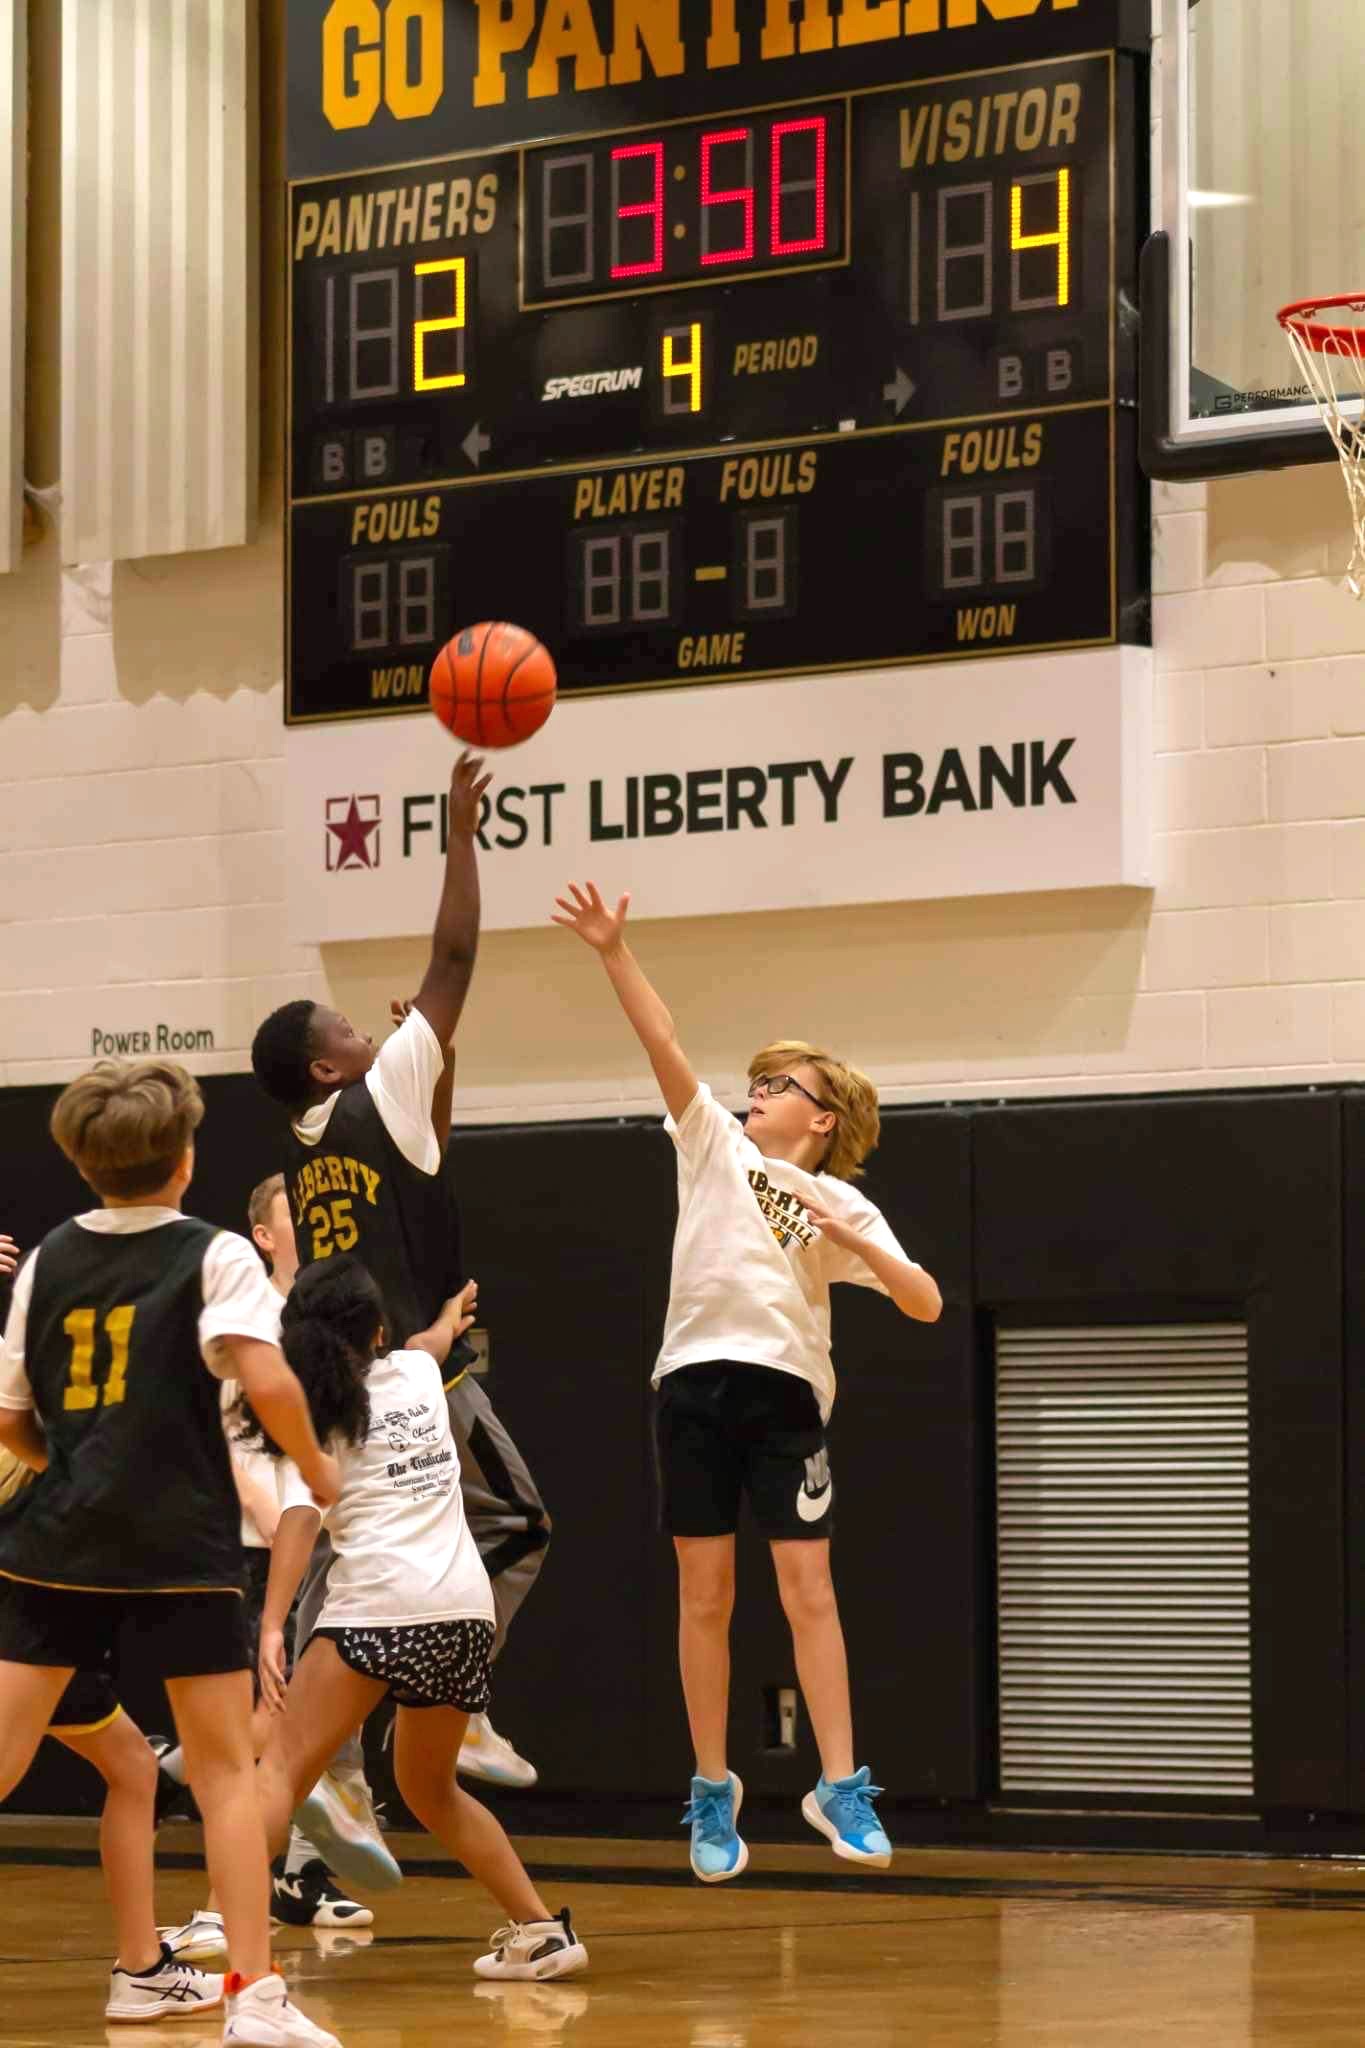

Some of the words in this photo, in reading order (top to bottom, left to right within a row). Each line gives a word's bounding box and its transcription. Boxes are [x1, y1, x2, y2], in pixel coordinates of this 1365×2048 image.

[322, 0, 444, 131] GO
[900, 82, 1082, 170] VISITOR
[295, 173, 498, 261] PANTHERS
[610, 116, 827, 280] 3:50
[1010, 167, 1070, 307] 4
[413, 257, 466, 392] 2
[733, 335, 818, 376] PERIOD
[542, 367, 643, 402] SPECTRUM
[662, 323, 701, 412] 4
[941, 423, 1043, 477] FOULS
[574, 466, 686, 520] PLAYER
[720, 451, 818, 503] FOULS
[351, 496, 442, 545] FOULS
[677, 632, 747, 669] GAME
[956, 604, 1018, 642] WON
[370, 665, 424, 700] WON
[589, 757, 854, 843] LIBERTY
[883, 737, 1076, 819] BANK
[748, 1169, 806, 1217] IBERT
[308, 1198, 359, 1260] 25
[63, 1304, 136, 1411] 11
